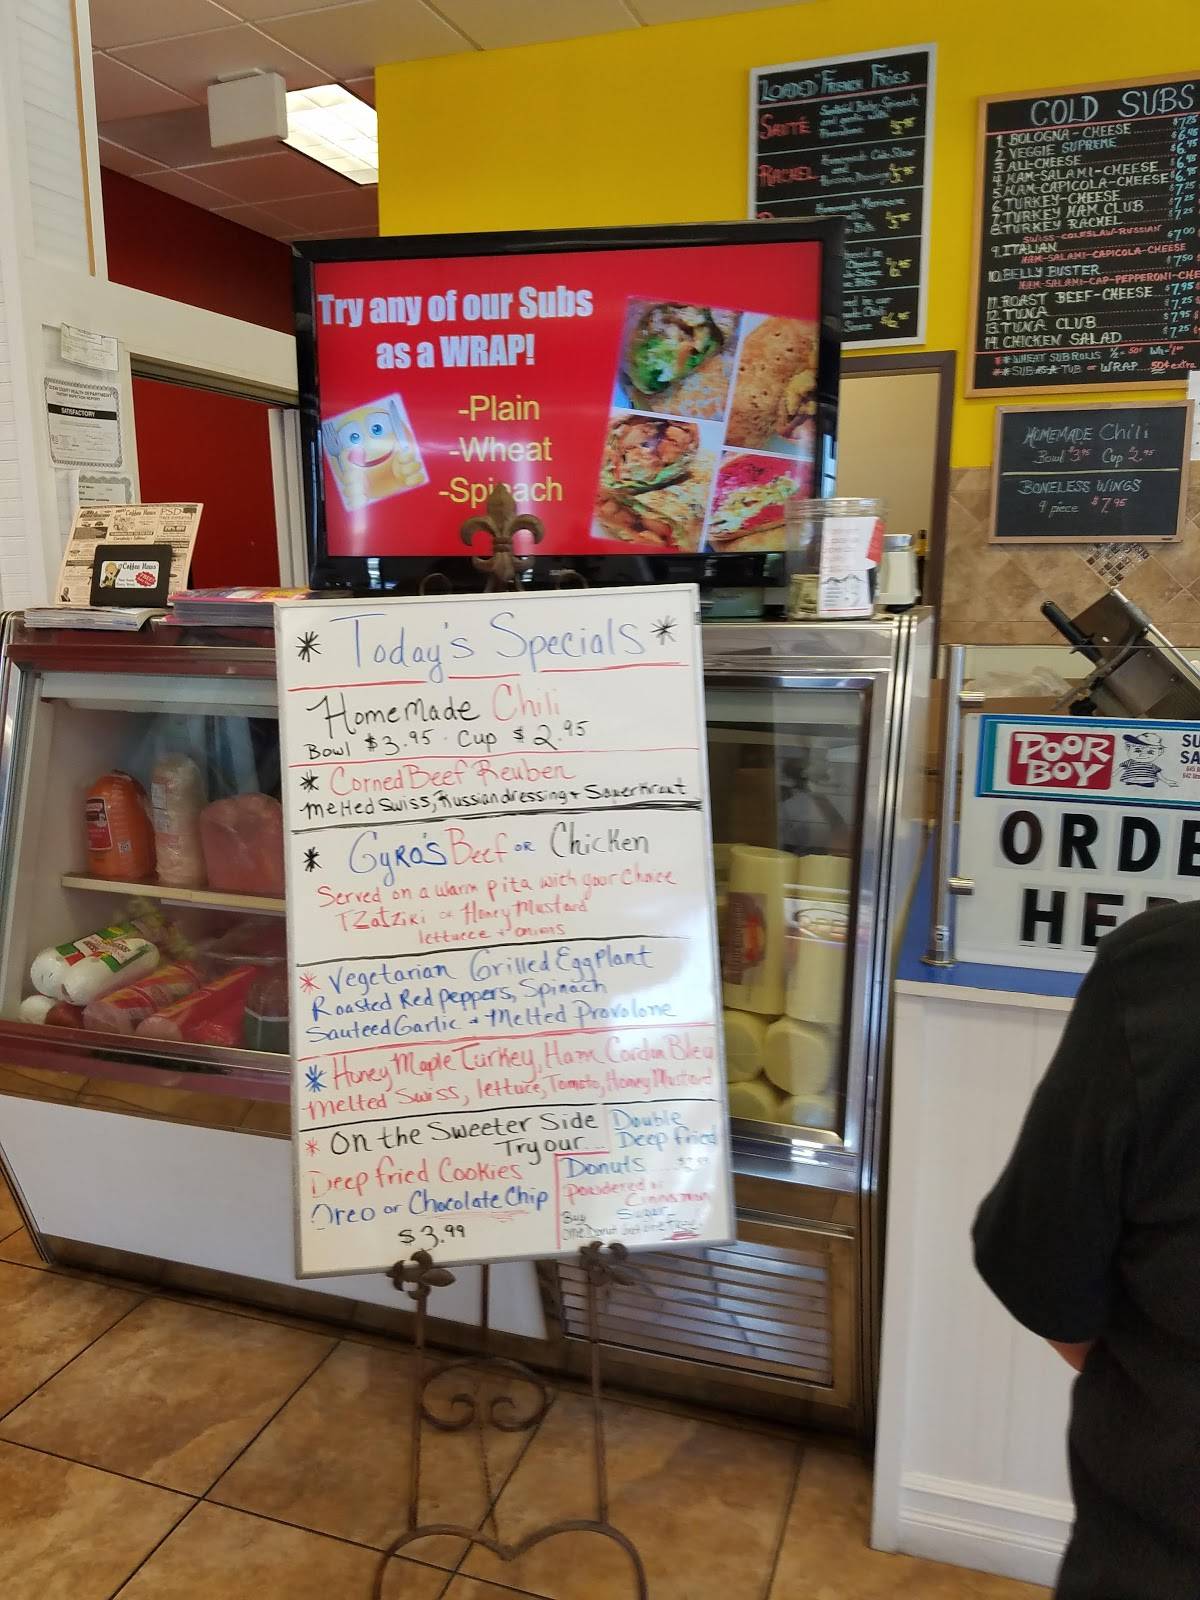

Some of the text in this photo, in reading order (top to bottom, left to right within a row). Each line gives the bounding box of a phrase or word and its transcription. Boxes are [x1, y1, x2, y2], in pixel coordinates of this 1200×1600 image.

[1030, 83, 1196, 126] COLD SUBS
[1002, 206, 1061, 223] TURKEY
[1103, 200, 1145, 215] CLUB
[1001, 219, 1061, 237] TURKEY
[1002, 242, 1058, 257] ITALIAN
[1048, 264, 1102, 278] BUSTER
[317, 286, 594, 328] Try any of our Subs
[1001, 292, 1050, 309] ROAST
[1055, 316, 1098, 330] CLUB
[376, 333, 536, 370] as a WRAP!
[1001, 333, 1063, 349] CHICKEN
[1068, 331, 1123, 346] SALAD
[457, 394, 541, 423] -Plain
[449, 435, 553, 463] -Wheat
[1101, 447, 1124, 468] Cup
[438, 476, 564, 509] -Spiach
[1016, 478, 1143, 495] BONELESS WINGS
[328, 611, 646, 684] Today's Specials
[491, 682, 561, 722] Chili
[303, 741, 351, 760] Bowl
[457, 728, 498, 753] Cup
[1014, 733, 1112, 765] POOR
[329, 758, 577, 797] Corned Beef Reuben
[1026, 758, 1105, 787] BOY
[502, 786, 568, 806] dressing
[443, 827, 508, 866] Beef
[316, 884, 382, 908] Served
[391, 888, 412, 901] on
[418, 887, 431, 899] a
[434, 880, 479, 898] warm
[486, 875, 534, 902] pita
[539, 868, 578, 890] with
[460, 900, 512, 931] Honey
[327, 963, 457, 996] Vegetarian
[469, 948, 551, 983] Grilled
[311, 991, 393, 1022] Roasted
[399, 986, 433, 1010] Red
[518, 977, 609, 1008] Spinach
[305, 1017, 391, 1043] Sauteed
[394, 1013, 463, 1037] Garlic
[571, 998, 678, 1029] Provolone
[331, 1053, 395, 1093] Honey
[330, 1110, 599, 1156] On the Sweeter Side
[609, 1107, 685, 1131] Double
[493, 1138, 543, 1166] Try
[613, 1130, 668, 1152] Deep
[305, 1169, 370, 1200] Deep
[438, 1156, 524, 1183] Cookies
[383, 1204, 403, 1215] or
[408, 1188, 503, 1216] Chocolate
[504, 1185, 550, 1212] Chip
